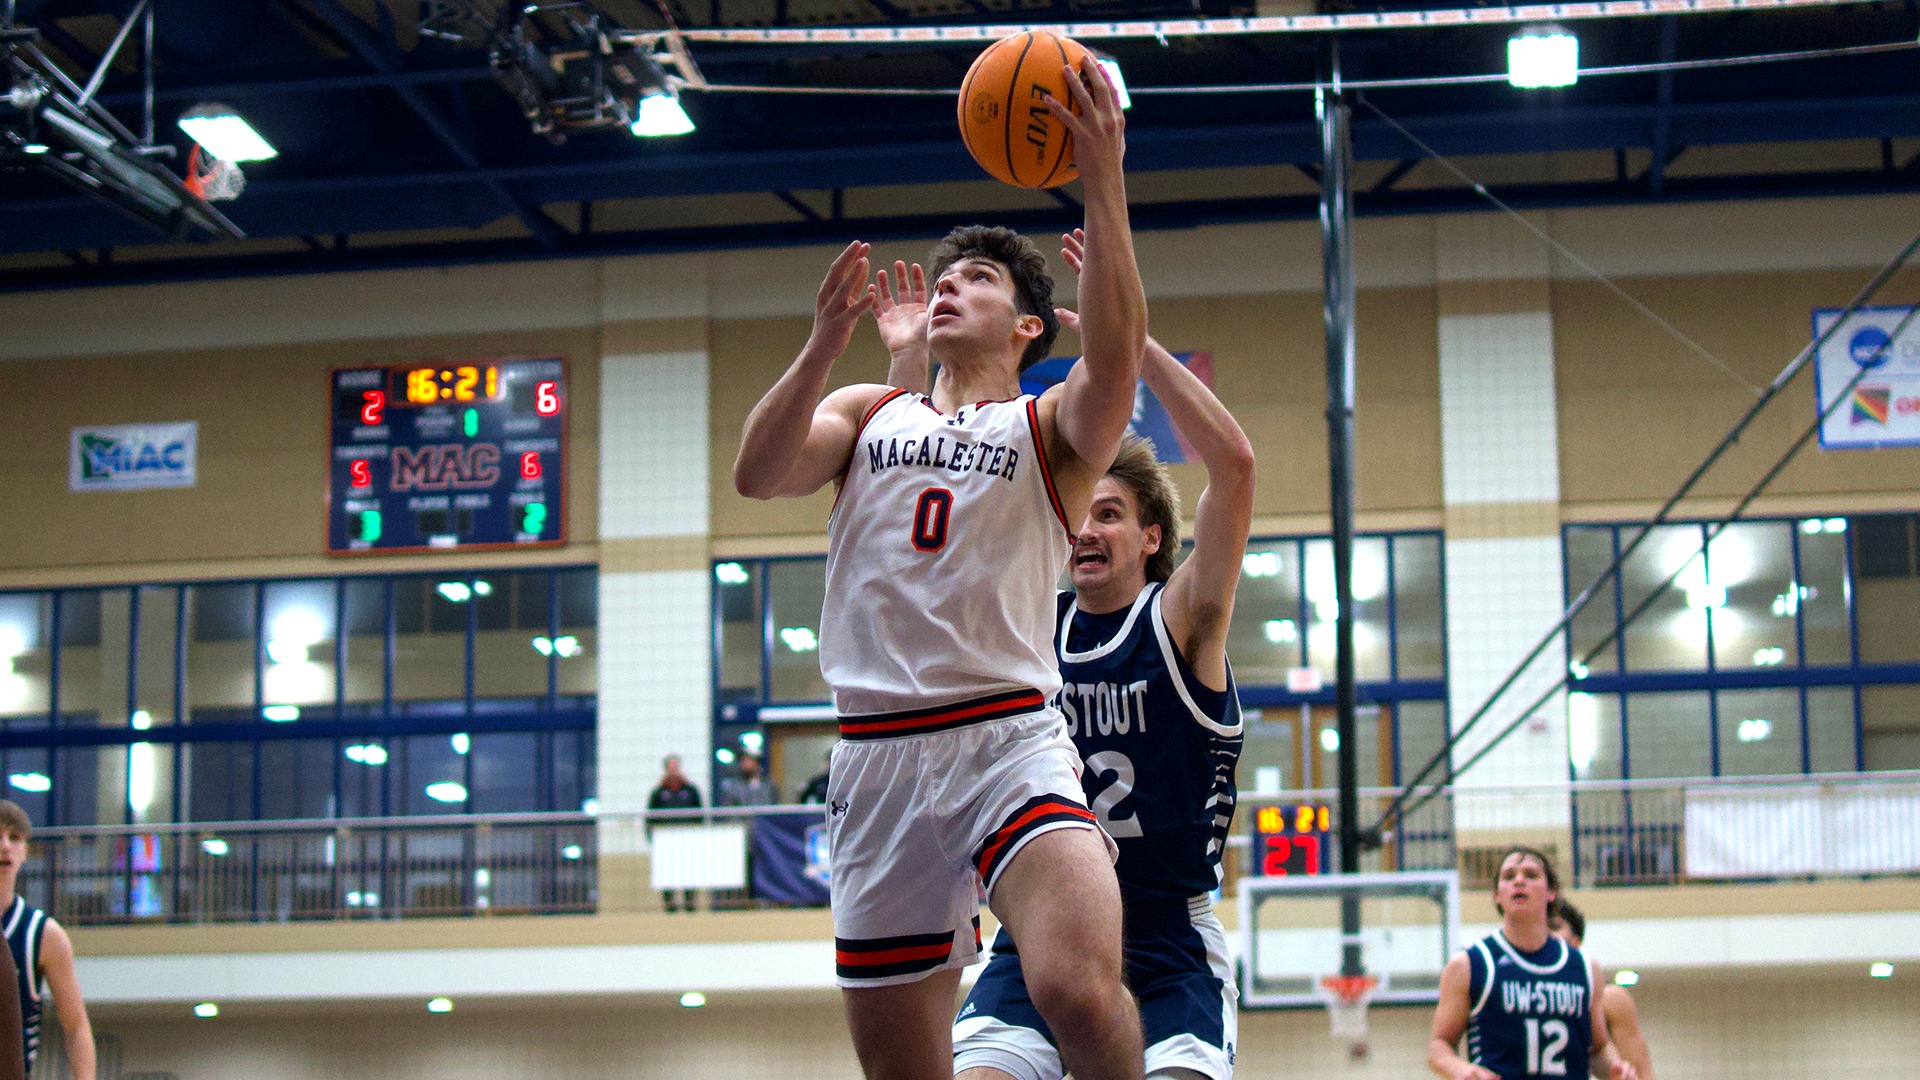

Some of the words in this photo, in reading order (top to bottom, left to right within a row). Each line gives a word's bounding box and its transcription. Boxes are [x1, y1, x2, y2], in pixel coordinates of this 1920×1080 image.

[1027, 83, 1052, 148] EVO
[407, 366, 498, 402] 16:21
[535, 381, 560, 416] 6
[361, 390, 385, 425] 2
[93, 441, 184, 472] MIAC
[350, 459, 372, 488] 5
[390, 443, 500, 491] MAC
[520, 451, 542, 480] 6
[868, 436, 1019, 481] MACALESTER
[911, 487, 954, 553] 0
[1263, 836, 1319, 877] 27
[1502, 981, 1585, 1017] UW-STOUT
[1525, 1018, 1569, 1076] 12
